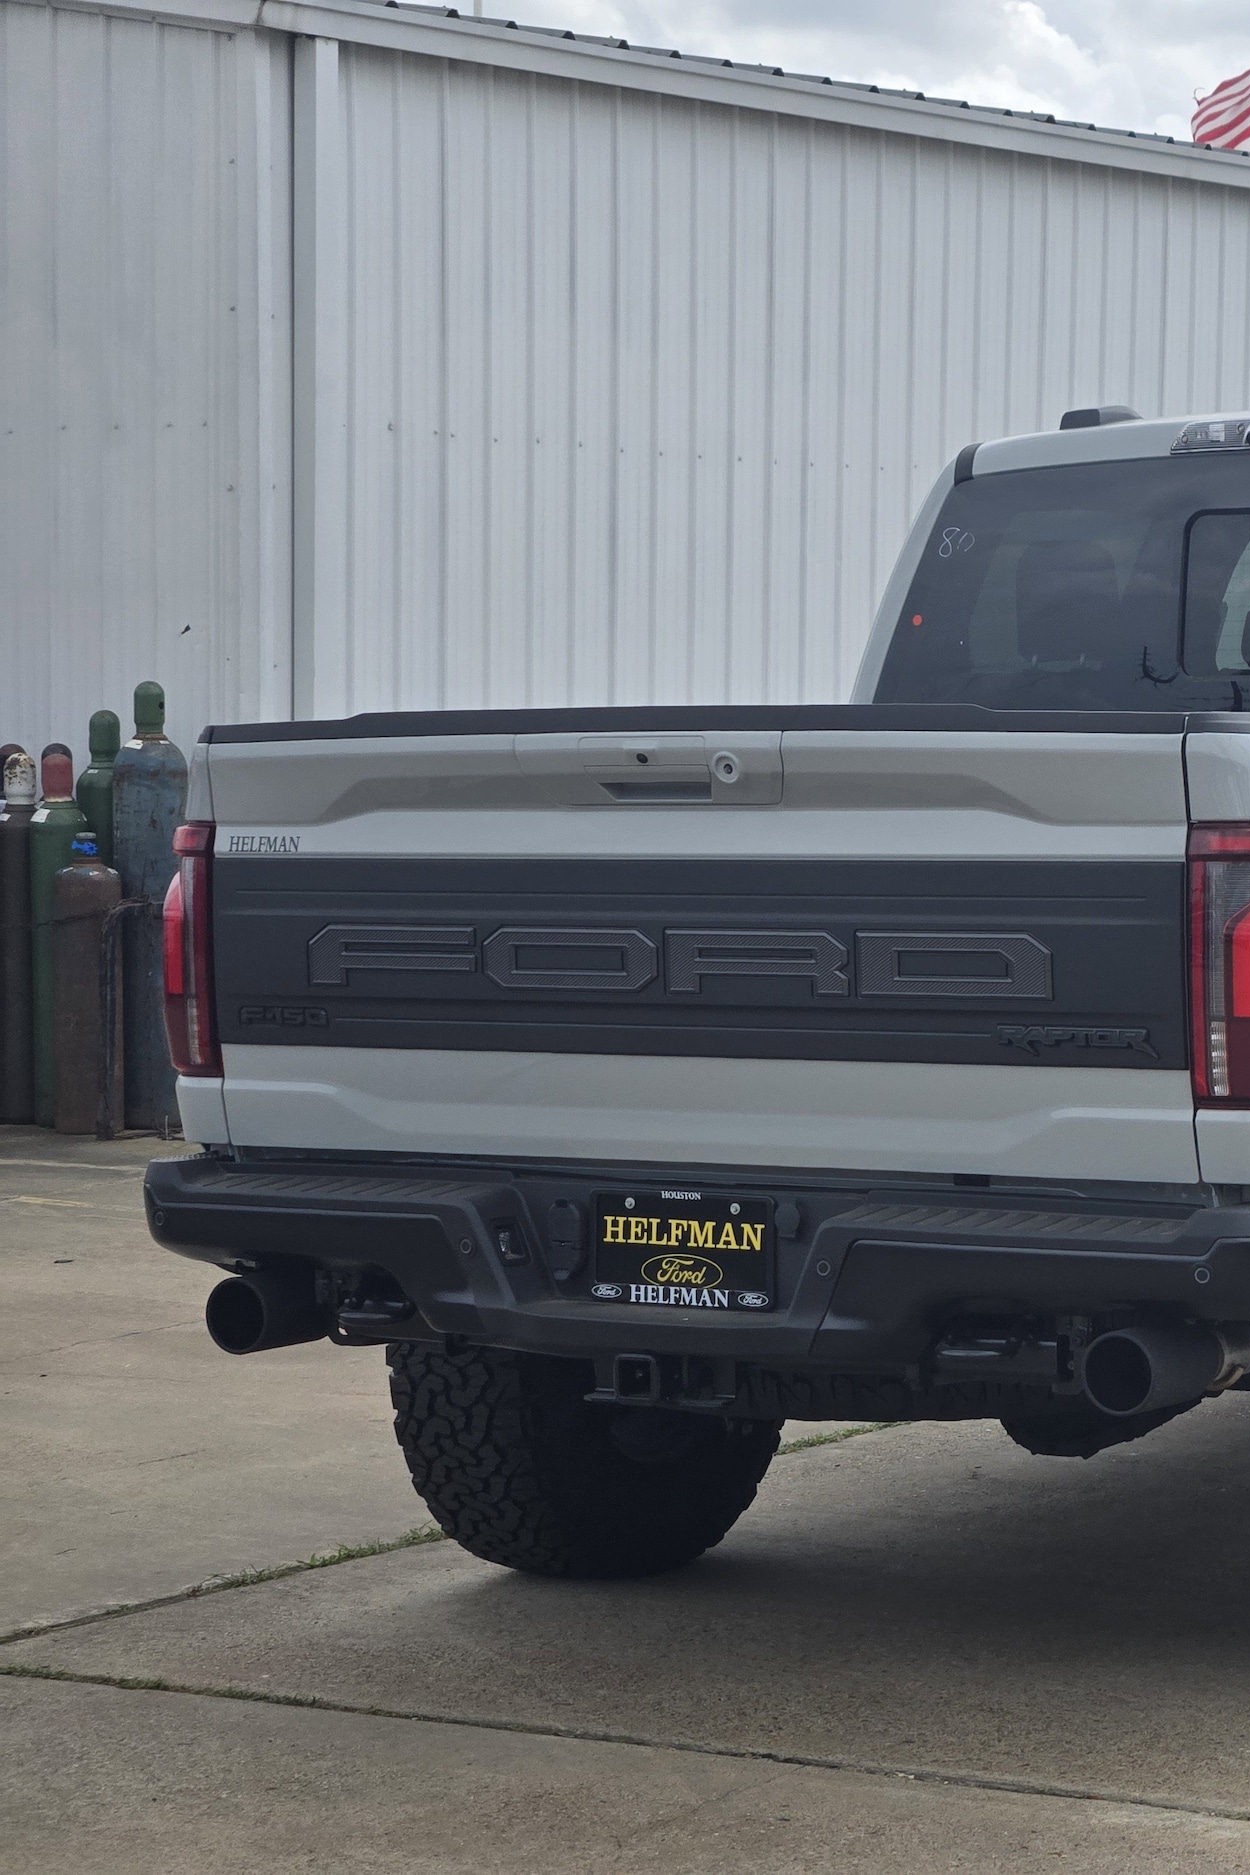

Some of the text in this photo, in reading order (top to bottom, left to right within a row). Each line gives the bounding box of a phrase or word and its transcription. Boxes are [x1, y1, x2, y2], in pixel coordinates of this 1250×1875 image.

[228, 835, 301, 853] HELFMAN
[307, 923, 1054, 1000] FORD
[997, 1023, 1160, 1060] RAPTOR
[660, 1190, 702, 1201] HOUSTON
[602, 1215, 766, 1251] HELFMAN
[656, 1257, 707, 1285] Ford
[596, 1284, 764, 1308] Ford HELFMAN Ford
